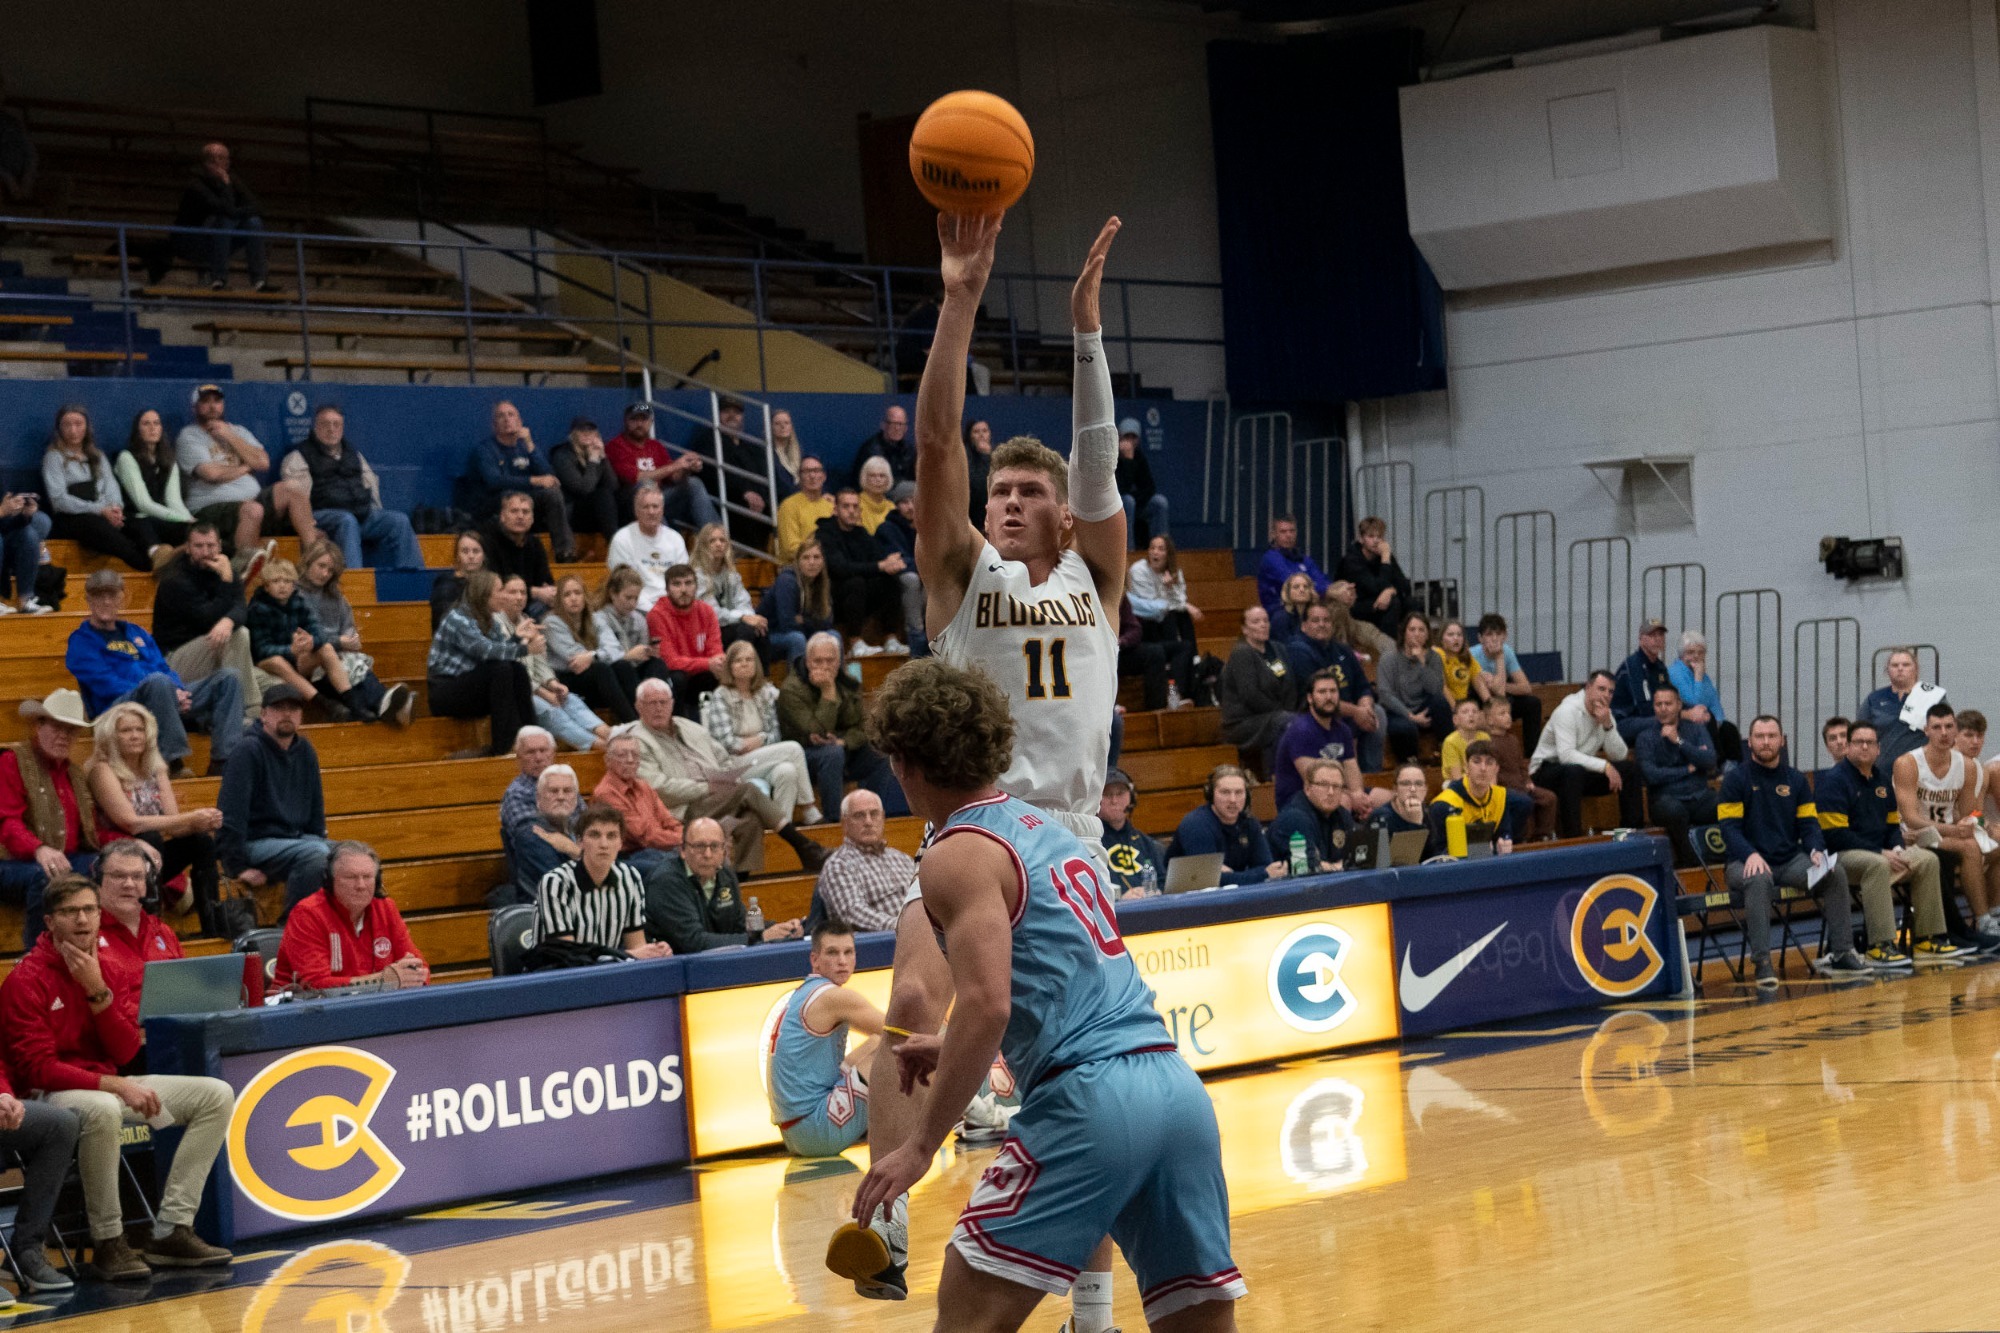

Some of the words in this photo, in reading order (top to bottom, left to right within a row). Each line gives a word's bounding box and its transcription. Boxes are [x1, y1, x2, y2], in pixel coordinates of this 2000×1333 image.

[921, 158, 1001, 192] Wilson
[1022, 637, 1072, 699] 11
[1048, 855, 1128, 964] 10
[1134, 937, 1211, 976] consin
[1166, 1003, 1217, 1057] re
[405, 1054, 684, 1143] #ROLLGOLDS
